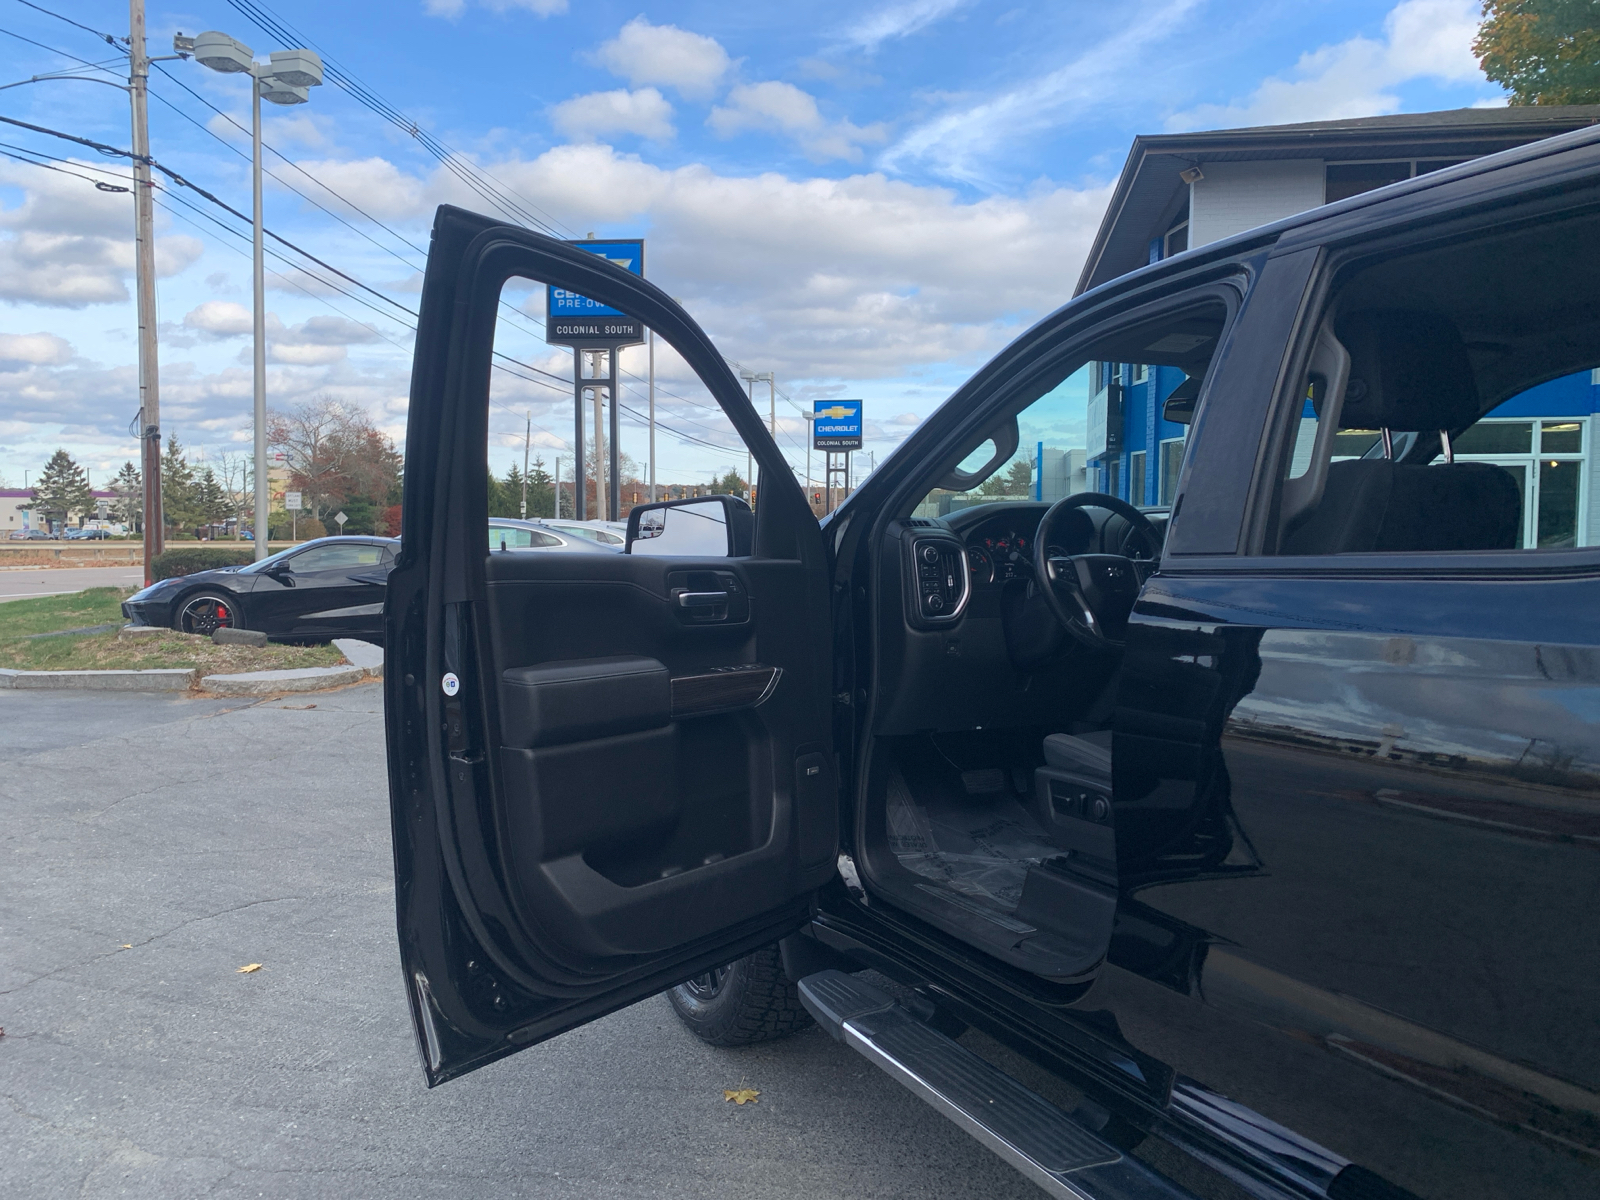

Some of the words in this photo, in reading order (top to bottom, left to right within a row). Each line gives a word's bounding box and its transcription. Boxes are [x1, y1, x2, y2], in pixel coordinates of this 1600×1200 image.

[558, 299, 606, 308] PRE-OW
[556, 325, 600, 334] COLONIAL
[604, 325, 634, 334] SOUTH
